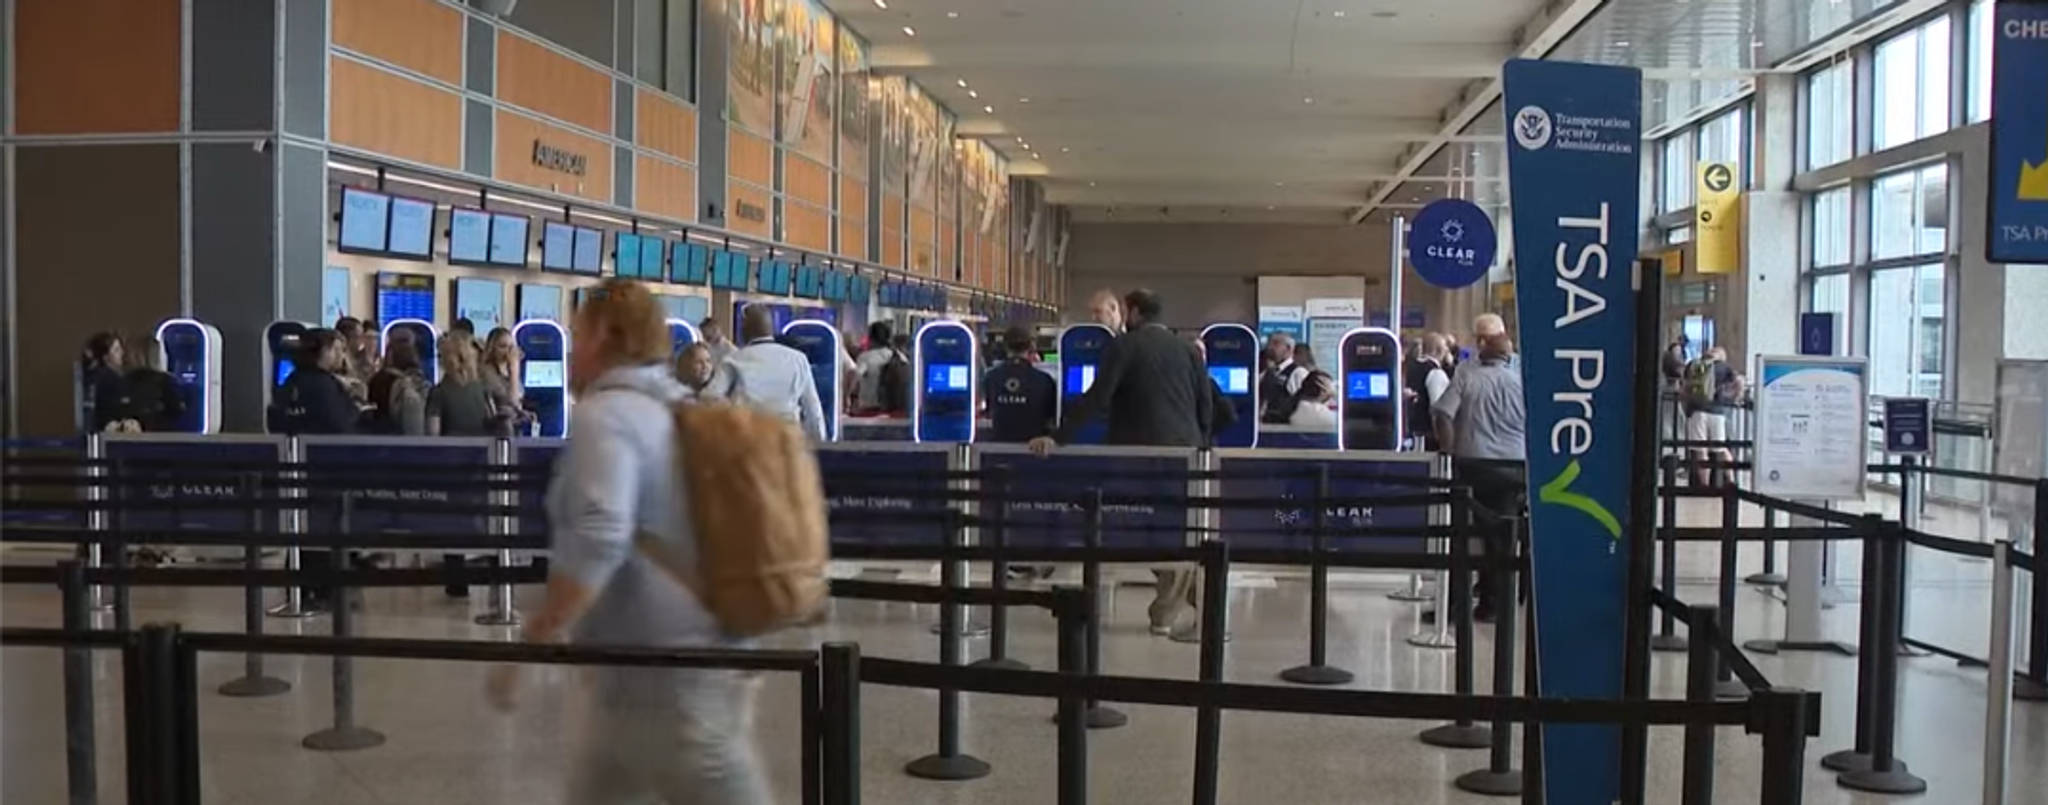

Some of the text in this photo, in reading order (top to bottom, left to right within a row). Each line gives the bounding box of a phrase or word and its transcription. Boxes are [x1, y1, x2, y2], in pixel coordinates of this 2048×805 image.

[1555, 113, 1631, 129] Transportation
[1555, 127, 1598, 141] Security
[1555, 139, 1632, 153] Administration
[532, 138, 587, 176] AMERICAN
[2002, 226, 2032, 241] TSA
[1427, 245, 1475, 260] CLEAR
[1555, 202, 1608, 328] TSA
[1551, 349, 1604, 454] Pre
